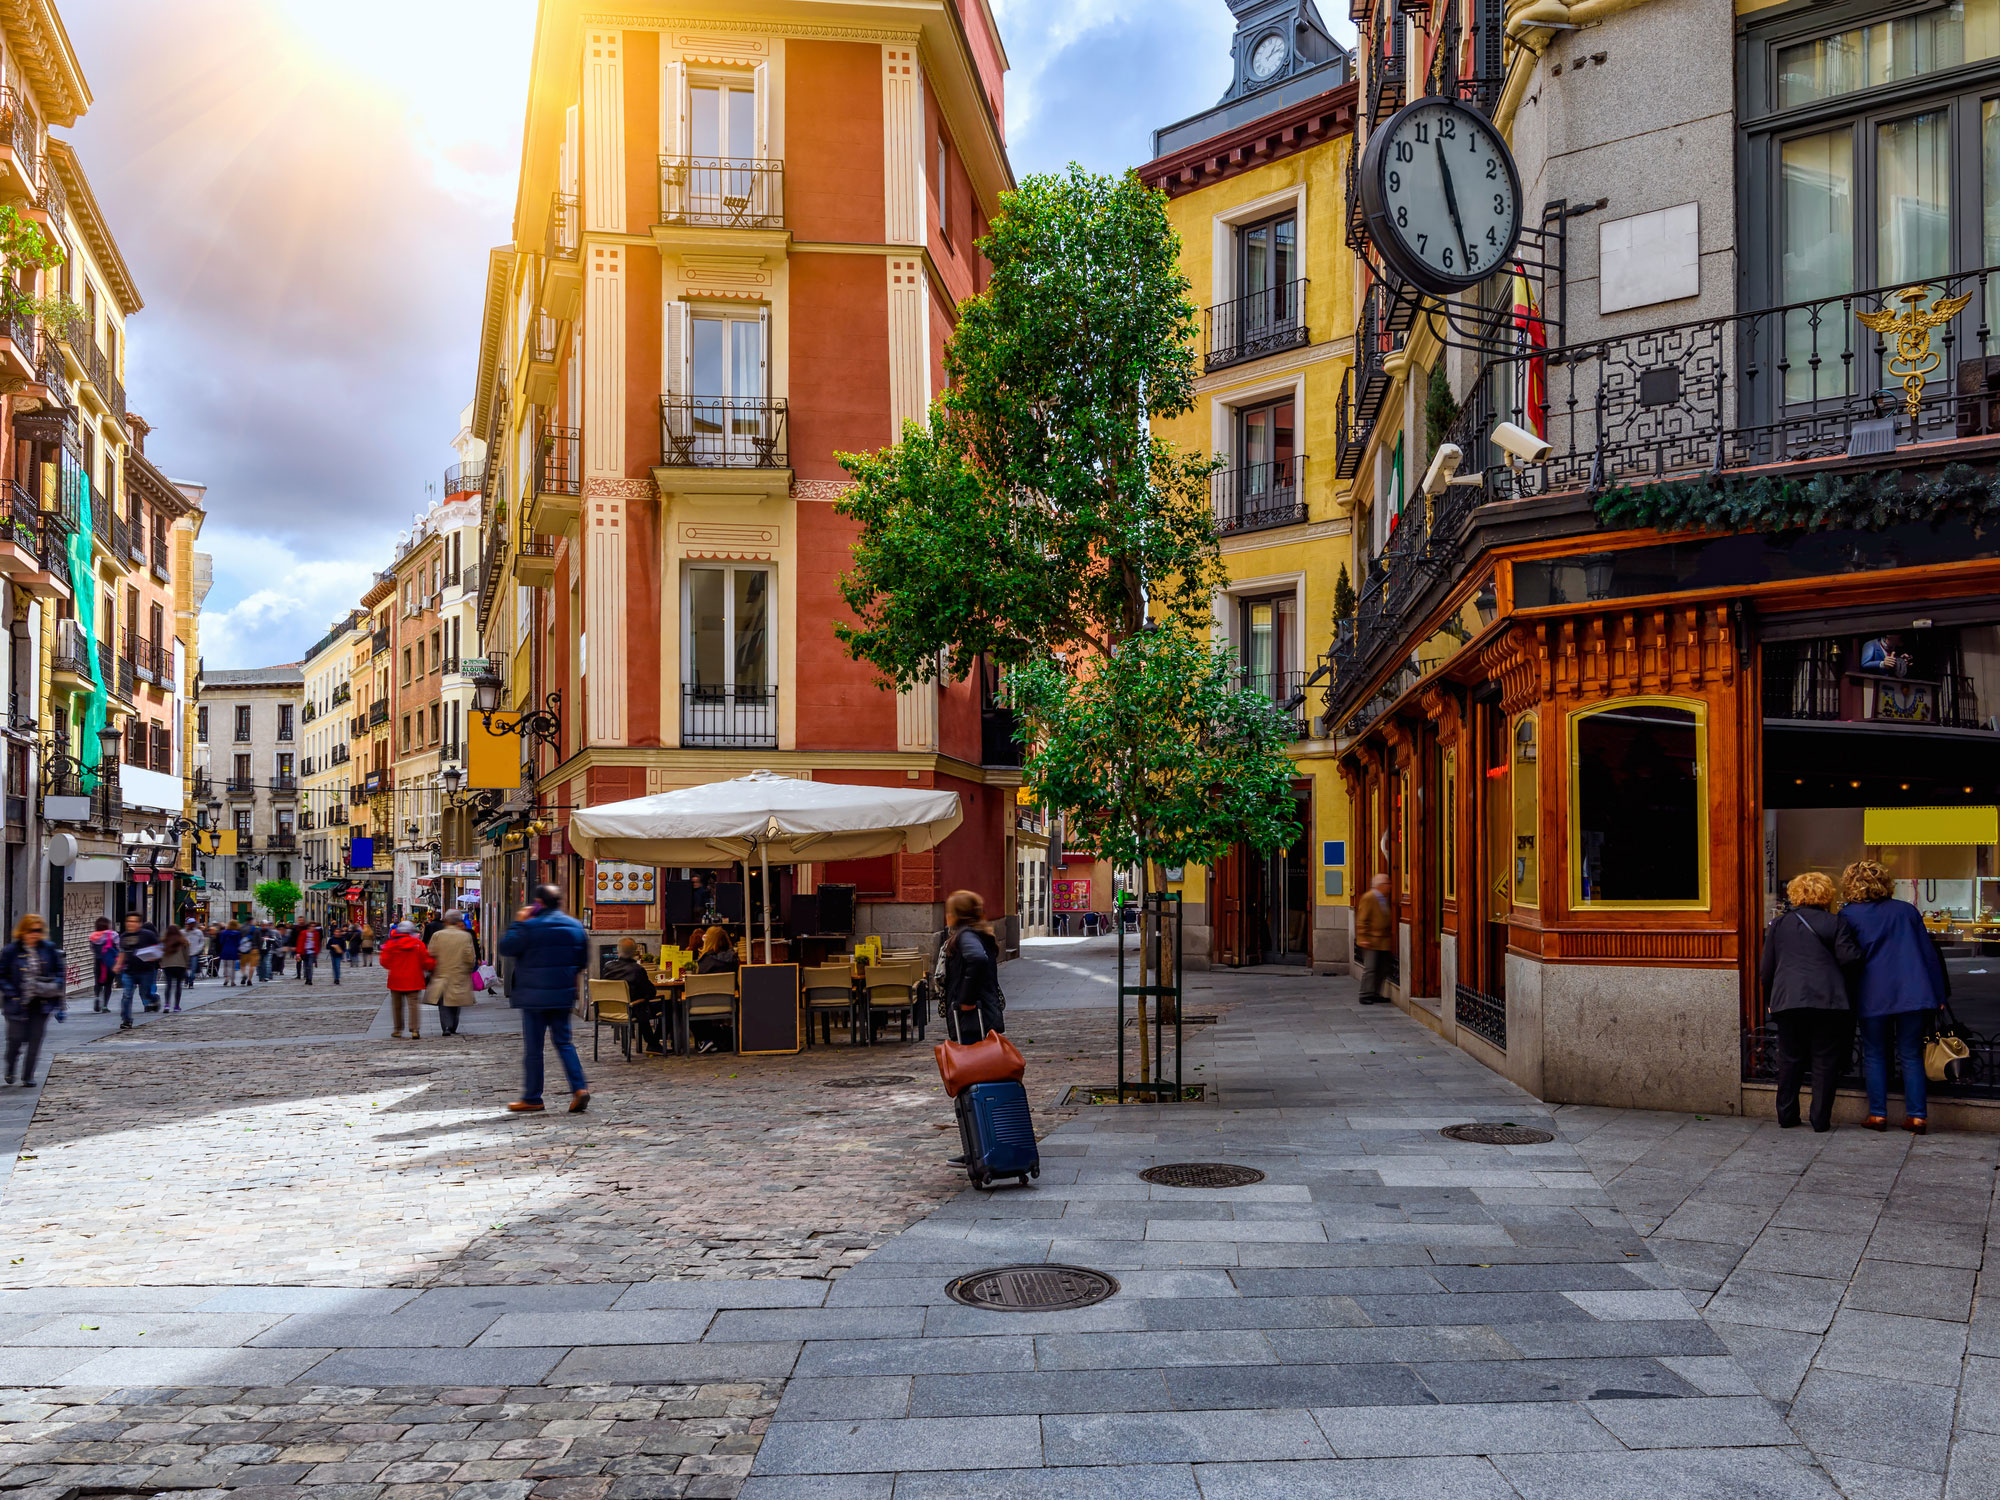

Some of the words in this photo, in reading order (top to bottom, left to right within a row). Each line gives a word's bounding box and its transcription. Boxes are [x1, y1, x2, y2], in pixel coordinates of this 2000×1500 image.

[1415, 122, 1429, 144] 11
[1437, 117, 1456, 140] 12
[1395, 141, 1413, 163] 10
[1469, 133, 1477, 153] 1
[1486, 158, 1496, 180] 2
[1389, 171, 1401, 192] 9
[1493, 194, 1504, 215] 3
[1397, 206, 1408, 228] 8
[1417, 233, 1428, 255] 7
[1486, 226, 1497, 246] 4
[1442, 248, 1453, 268] 6
[1468, 244, 1479, 265] 5
